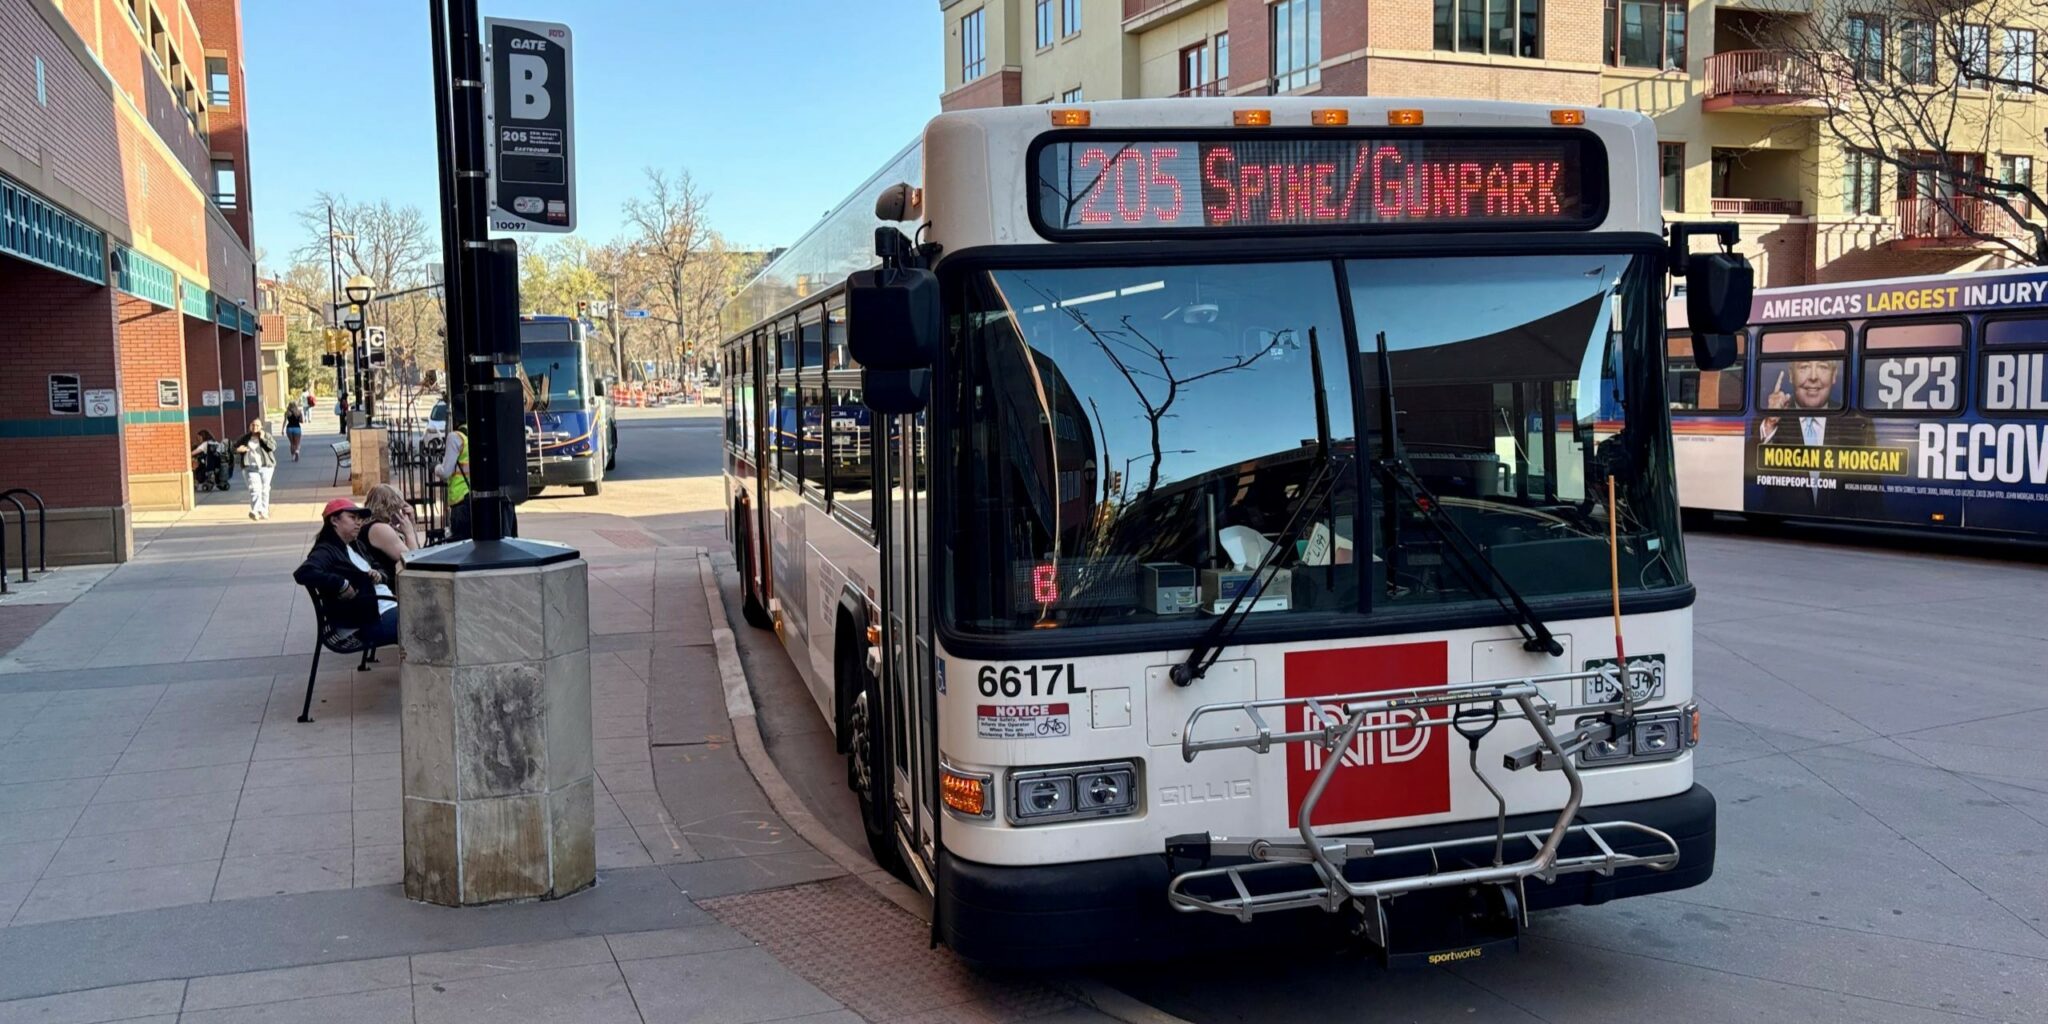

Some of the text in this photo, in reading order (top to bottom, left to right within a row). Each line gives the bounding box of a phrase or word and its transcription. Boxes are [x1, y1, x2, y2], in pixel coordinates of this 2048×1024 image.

[510, 38, 547, 51] GATE
[508, 53, 551, 120] B
[502, 130, 528, 142] 205
[1080, 148, 1182, 223] 205
[496, 222, 526, 230] 10097
[1866, 287, 1958, 313] LARGEST
[1963, 281, 2048, 306] INJURY
[370, 333, 384, 347] C
[1878, 354, 2048, 410] $23 BIL
[1764, 447, 1900, 472] MORGAN & MORGAN
[1918, 422, 2048, 484] RECOV
[1756, 475, 1837, 489] FORTHEPEOPLE.COM
[1034, 565, 1057, 602] 6
[978, 663, 1086, 698] 6617L
[996, 704, 1050, 717] NOTICE
[1304, 703, 1431, 772] RTD
[1428, 948, 1482, 964] sportworks
